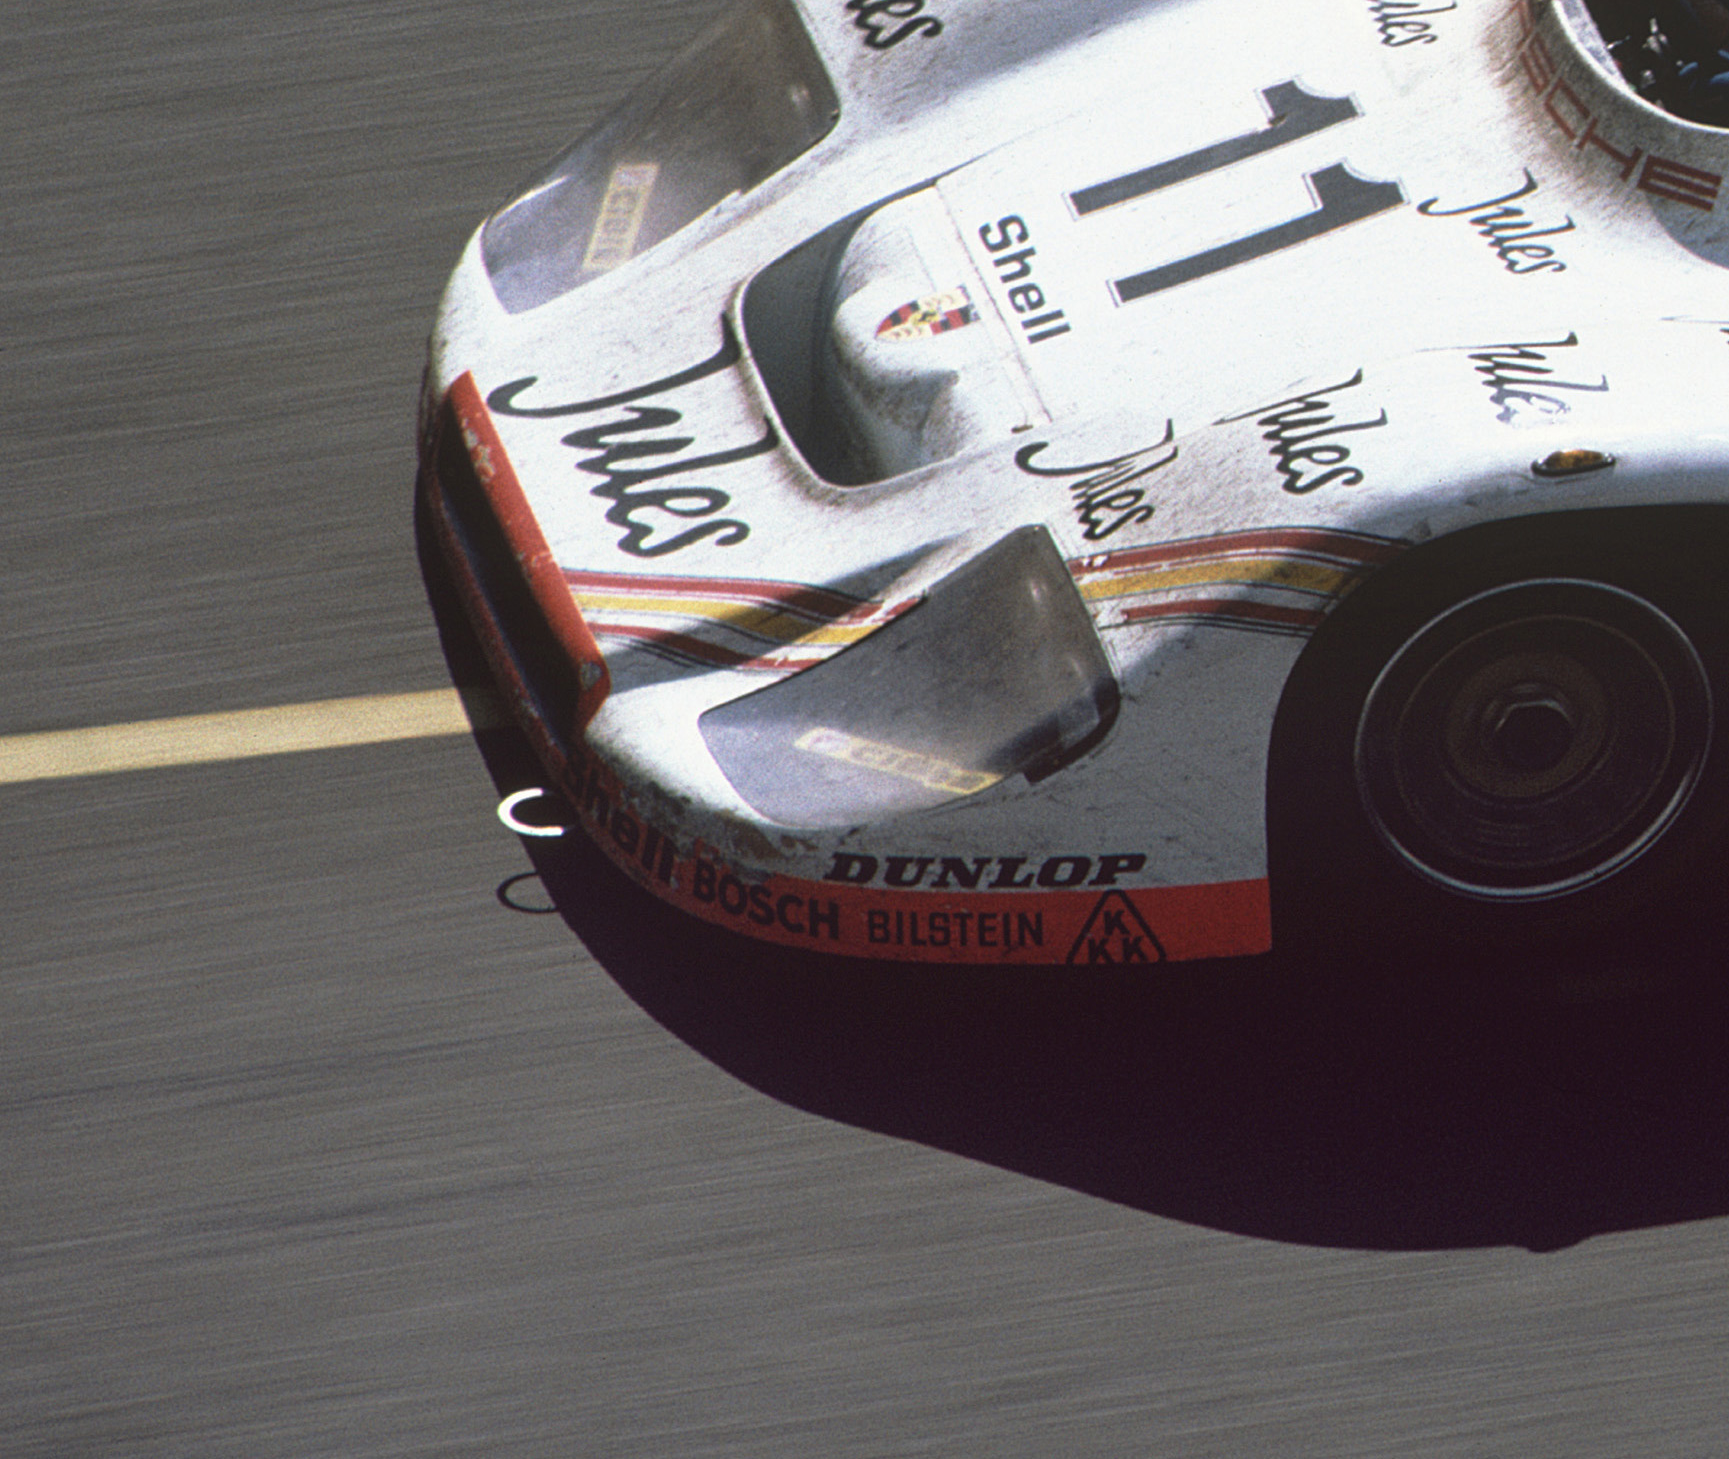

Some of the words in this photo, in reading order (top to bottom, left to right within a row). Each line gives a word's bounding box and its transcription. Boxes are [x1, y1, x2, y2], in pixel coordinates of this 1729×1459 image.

[1063, 76, 1409, 308] 11
[1417, 168, 1576, 275] Jules
[978, 214, 1071, 344] Shell
[486, 310, 779, 558] Jules
[1014, 418, 1178, 541] Jules
[1212, 367, 1389, 495] Jules
[691, 856, 840, 942] BOSCH
[824, 853, 1147, 889] DUNLOP
[867, 909, 1044, 949] BILSTEIN
